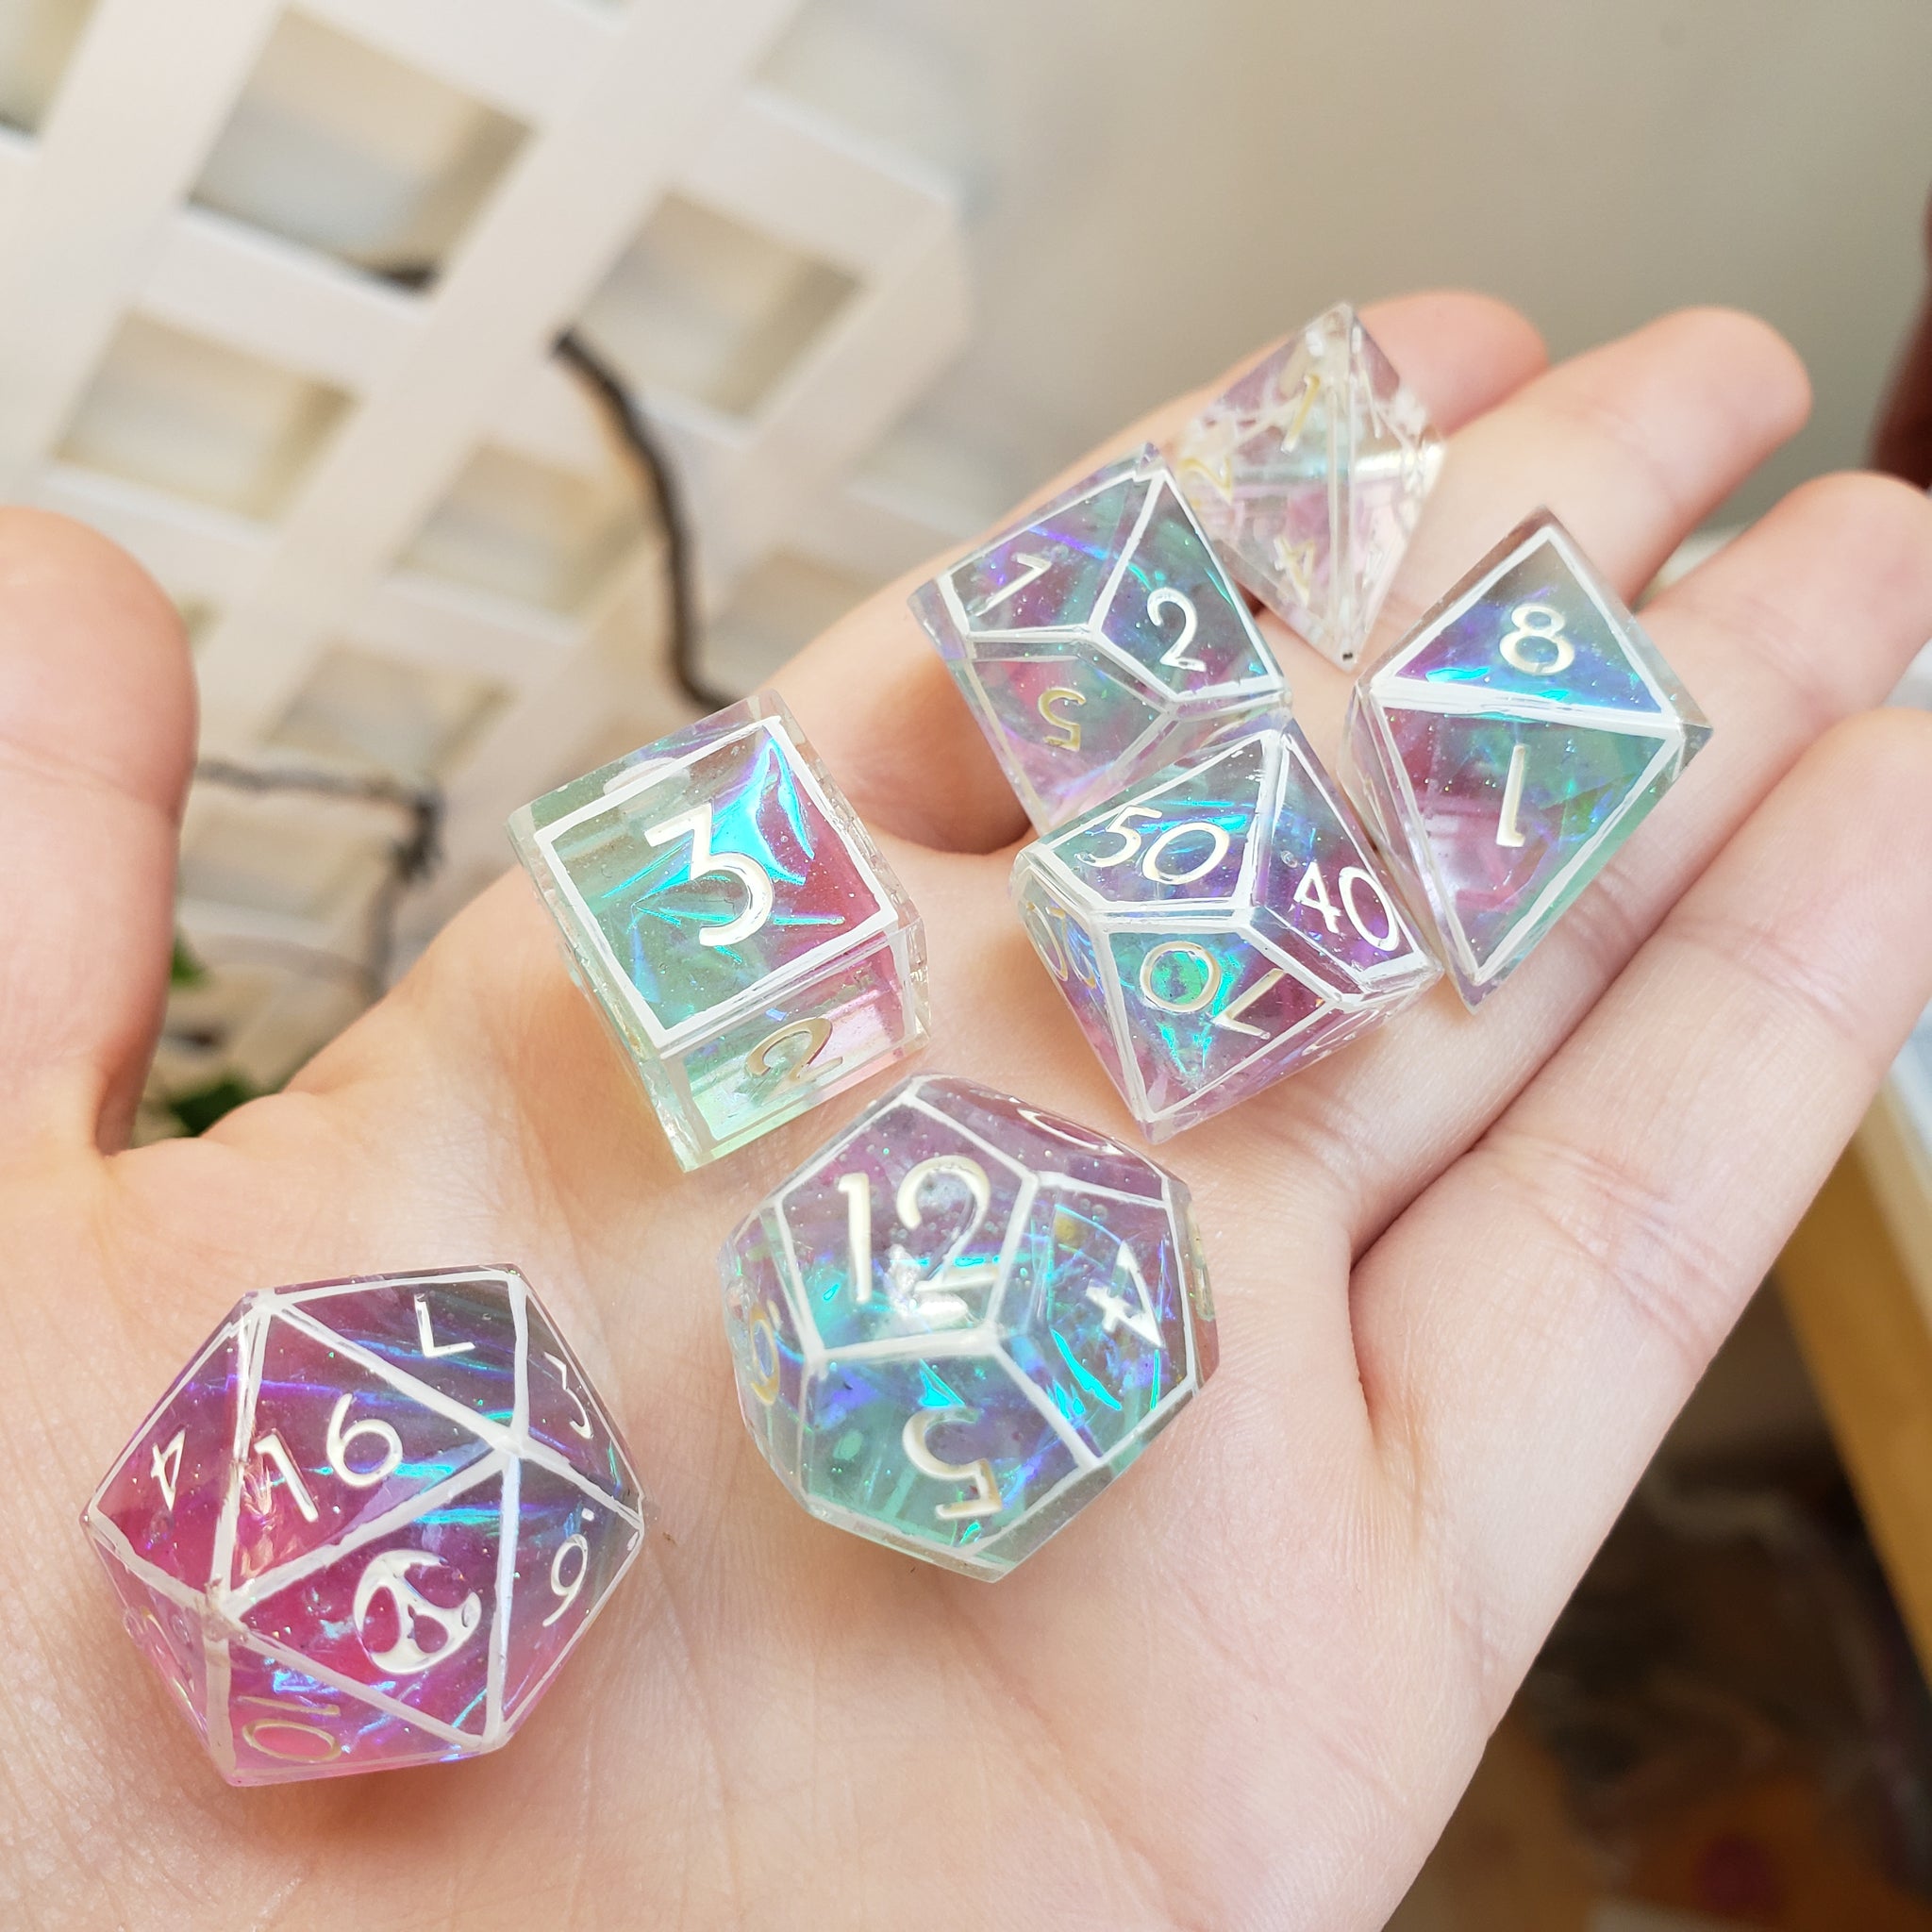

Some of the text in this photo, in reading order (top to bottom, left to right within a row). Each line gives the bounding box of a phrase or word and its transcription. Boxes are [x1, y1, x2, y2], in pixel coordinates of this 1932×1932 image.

[1146, 587, 1207, 673] 2
[1498, 603, 1575, 676] 8
[1038, 687, 1087, 752] 5
[1495, 742, 1525, 848] 1
[643, 804, 775, 947] 3
[1074, 804, 1230, 885] 50
[1293, 861, 1400, 952] 40
[743, 1017, 843, 1081] 2
[838, 1154, 1000, 1306] 12
[1085, 1239, 1164, 1348] 4
[149, 1428, 187, 1511] 4
[254, 1392, 404, 1524] 16
[902, 1407, 1004, 1521] 5
